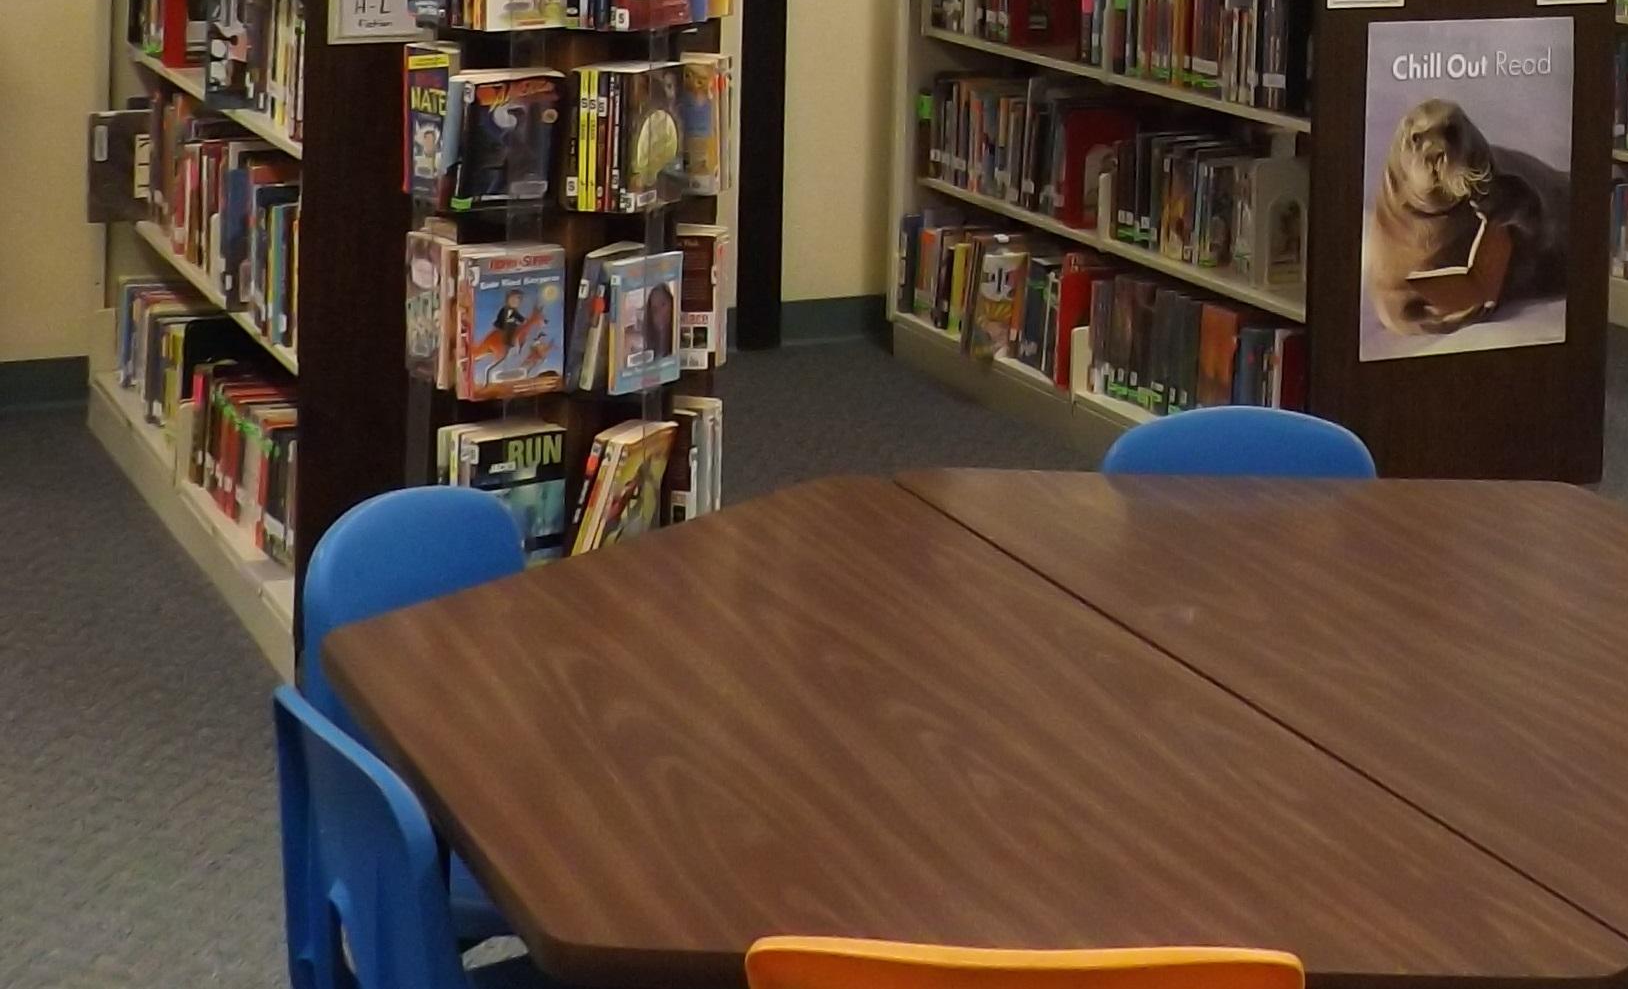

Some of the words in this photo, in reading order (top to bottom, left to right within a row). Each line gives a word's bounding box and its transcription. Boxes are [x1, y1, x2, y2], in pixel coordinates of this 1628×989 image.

[618, 12, 625, 23] S
[1392, 51, 1442, 81] Chill
[1446, 52, 1488, 79] Out
[1495, 46, 1553, 77] Read
[410, 86, 448, 117] NATE
[507, 433, 563, 468] RUN
